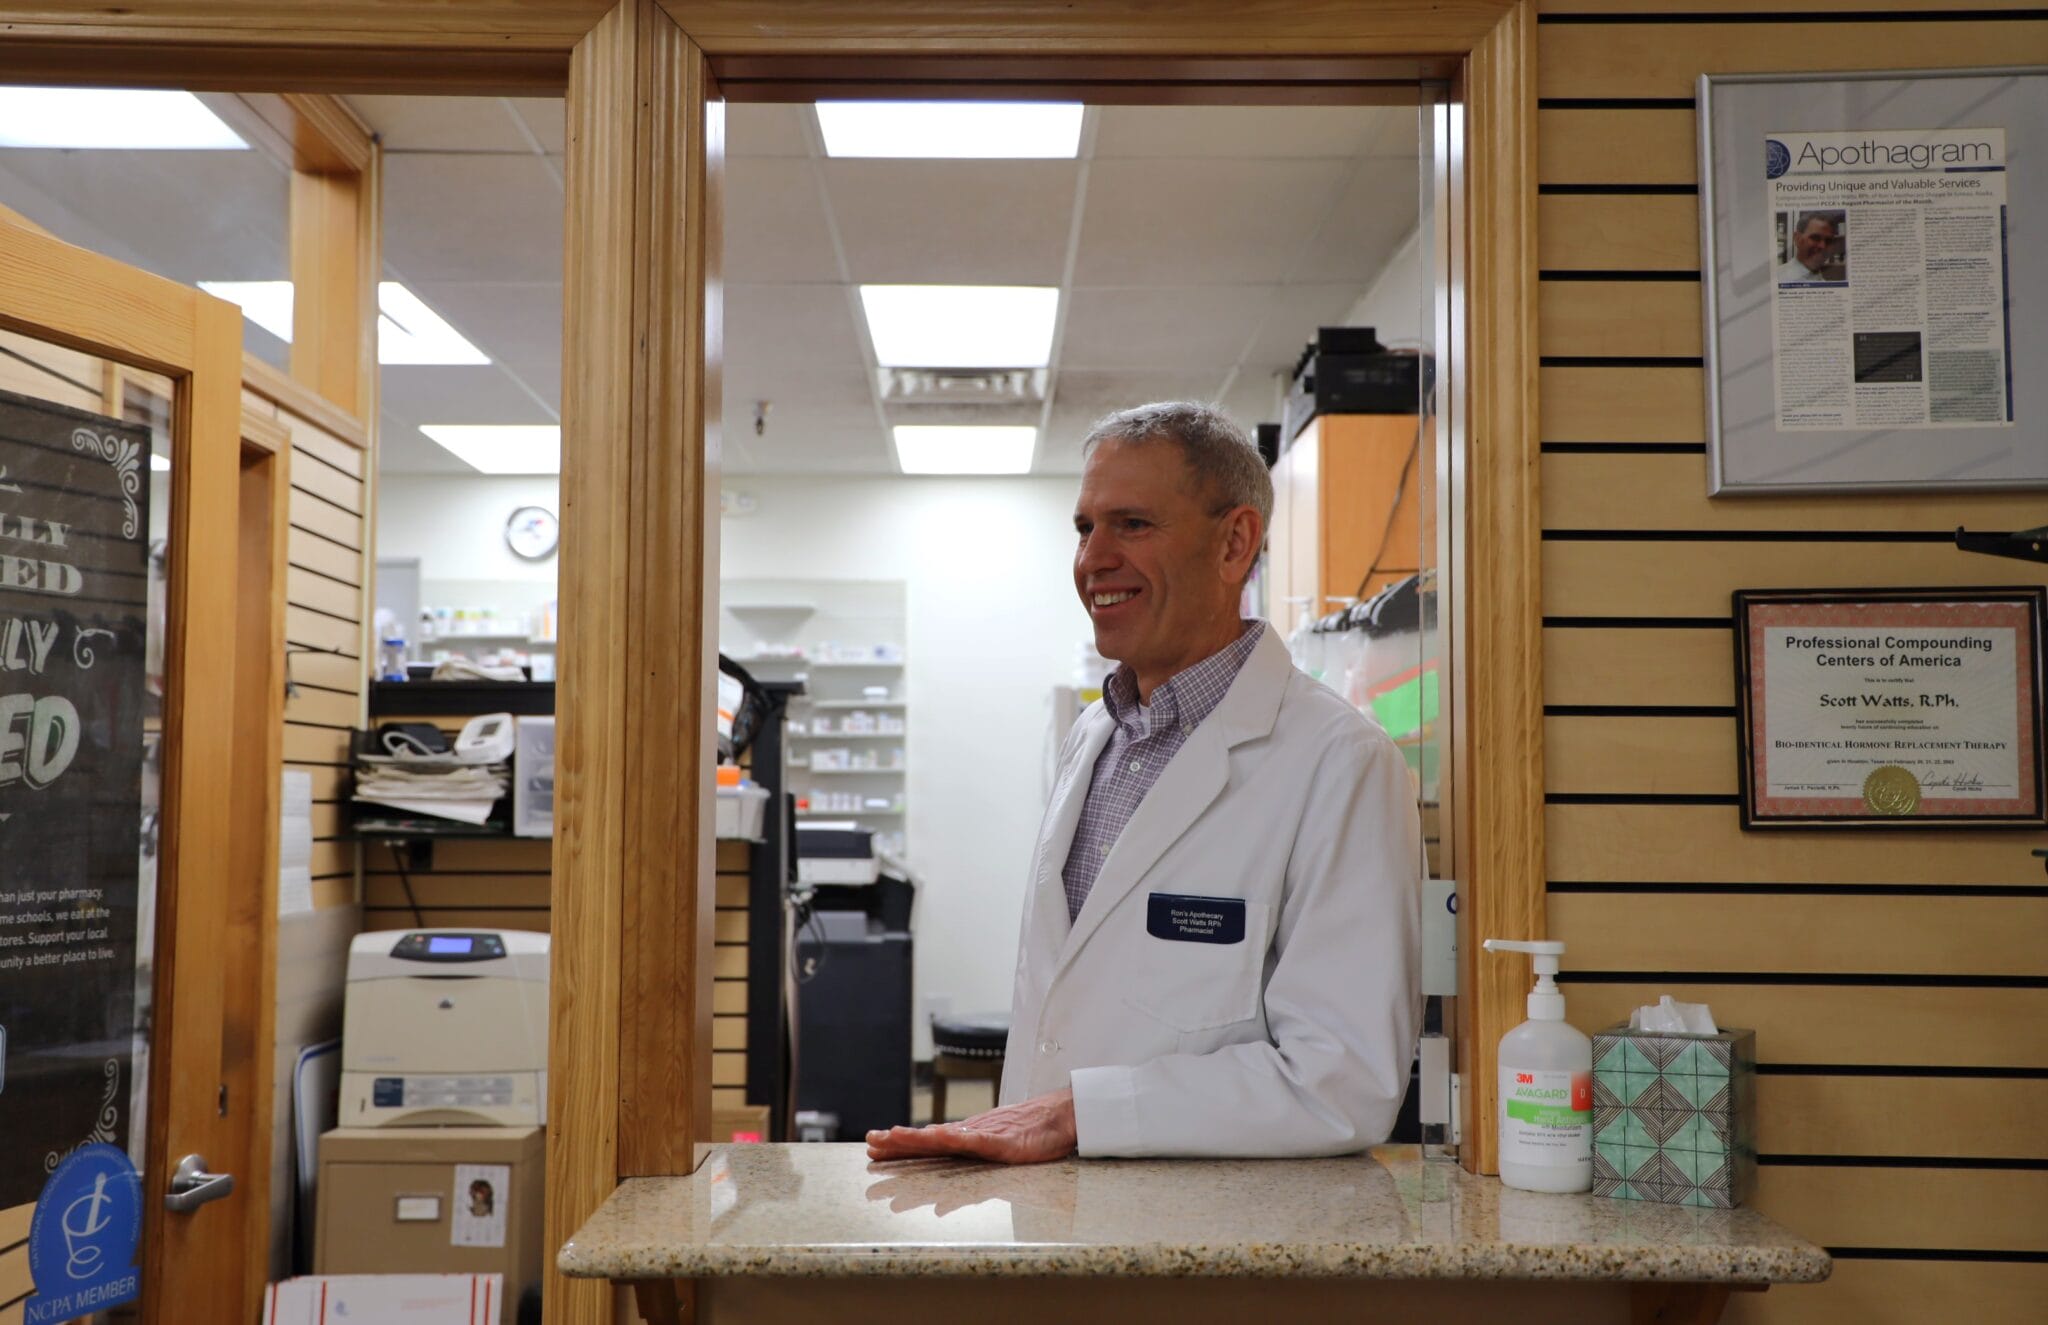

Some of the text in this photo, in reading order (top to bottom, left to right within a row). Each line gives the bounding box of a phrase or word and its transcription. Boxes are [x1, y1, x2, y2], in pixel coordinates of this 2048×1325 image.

[1797, 140, 1991, 171] Apothagram
[1775, 178, 1981, 193] Providing Unique and Valuable Services
[1786, 636, 1992, 652] Professional Compounding
[1816, 654, 1962, 667] Centers of America
[1820, 694, 1857, 707] Scott
[1919, 694, 1959, 707] R.Ph.
[1775, 740, 2007, 750] BIO-IDENTICAL HORMONE REPLACEMENT THERAPY
[18, 890, 36, 905] just
[36, 890, 58, 904] your
[58, 888, 104, 903] pharmacy.
[16, 909, 55, 924] schools,
[55, 911, 70, 922] we
[71, 909, 84, 921] eat
[96, 907, 111, 919] the
[1170, 909, 1224, 921] Ron's Apothecary
[1172, 917, 1222, 928] Scott Watts RPh
[28, 930, 65, 946] Support
[66, 931, 87, 944] your
[87, 926, 109, 941] local
[1179, 925, 1214, 935] Pharmacist
[25, 956, 32, 966] a
[33, 952, 62, 966] better
[62, 950, 87, 965] place
[88, 949, 97, 960] to
[98, 946, 116, 959] live.
[1515, 1073, 1533, 1084] 3M
[1515, 1087, 1568, 1099] AVAGARD
[27, 1275, 136, 1323] NCPA MEMBER
